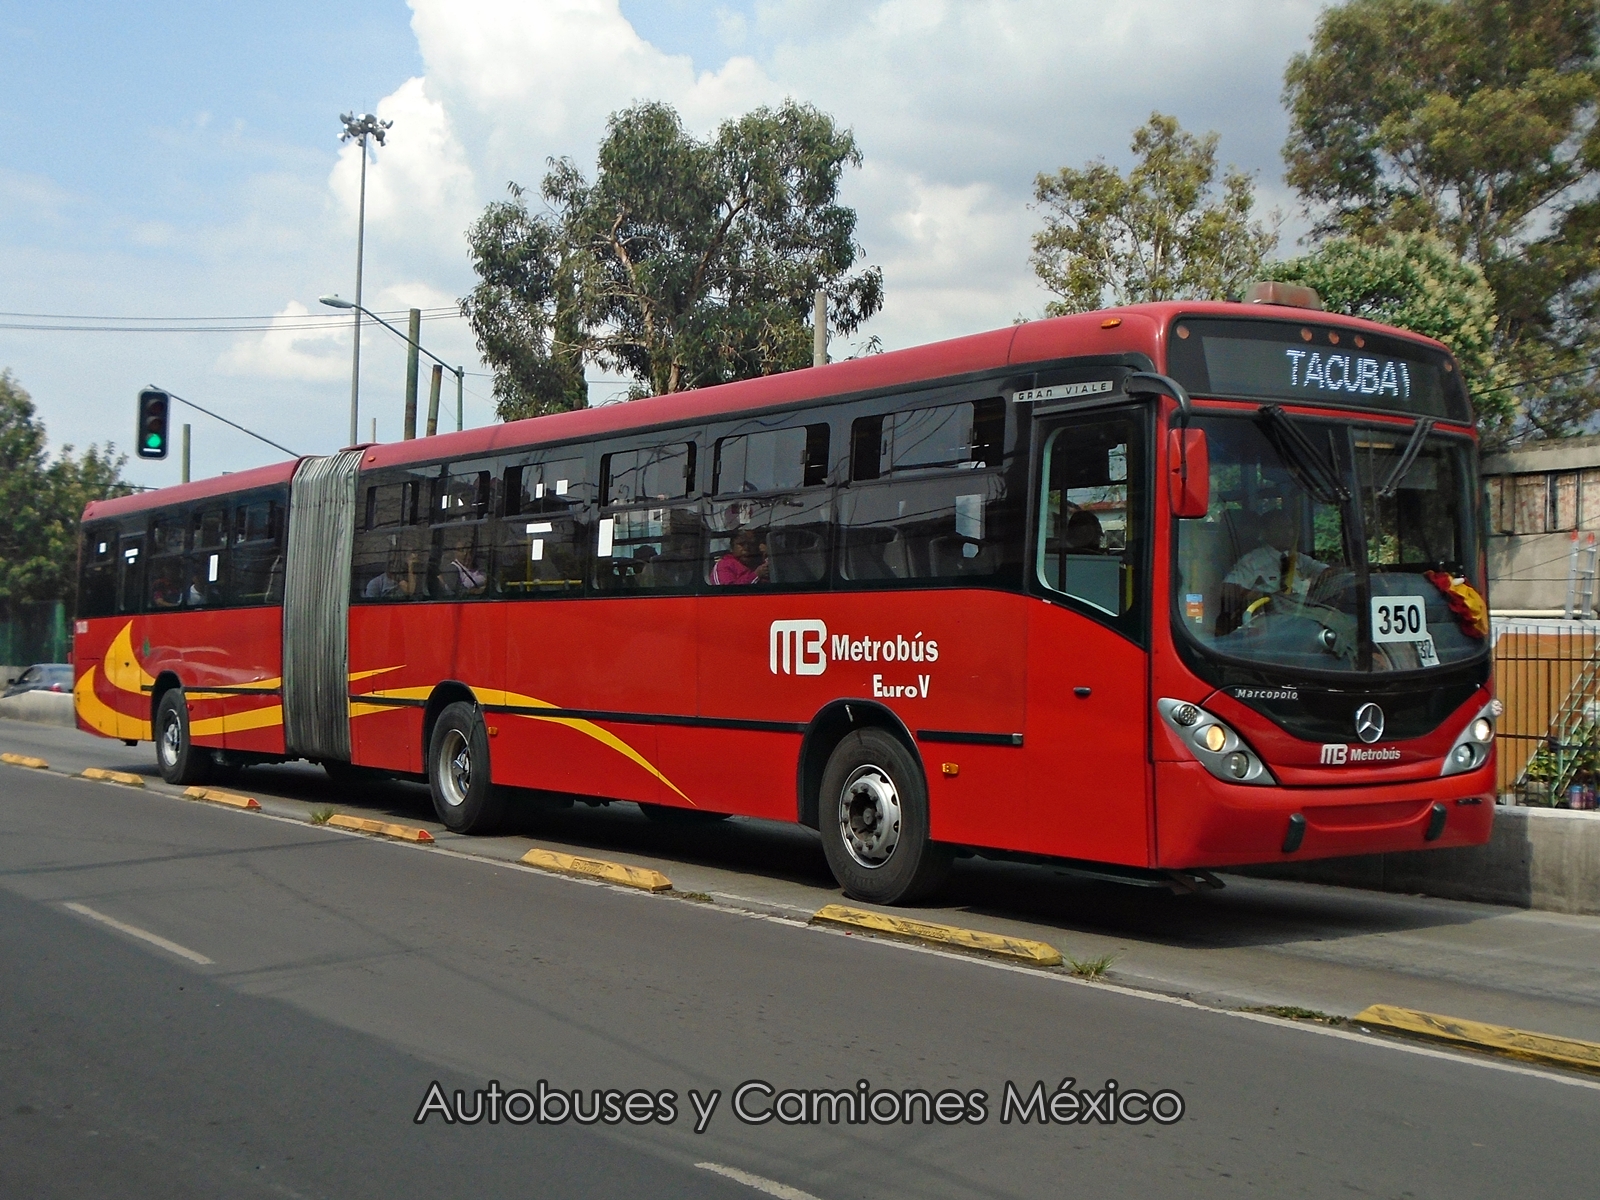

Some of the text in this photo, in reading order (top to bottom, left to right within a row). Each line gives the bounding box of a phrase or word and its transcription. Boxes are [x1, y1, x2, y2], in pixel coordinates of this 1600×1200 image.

[1018, 382, 1108, 401] GRAN VIALE
[1377, 604, 1421, 635] 350
[831, 631, 939, 662] Metrobús
[1236, 688, 1298, 700] Marcopolo
[1350, 746, 1401, 761] Metrobús
